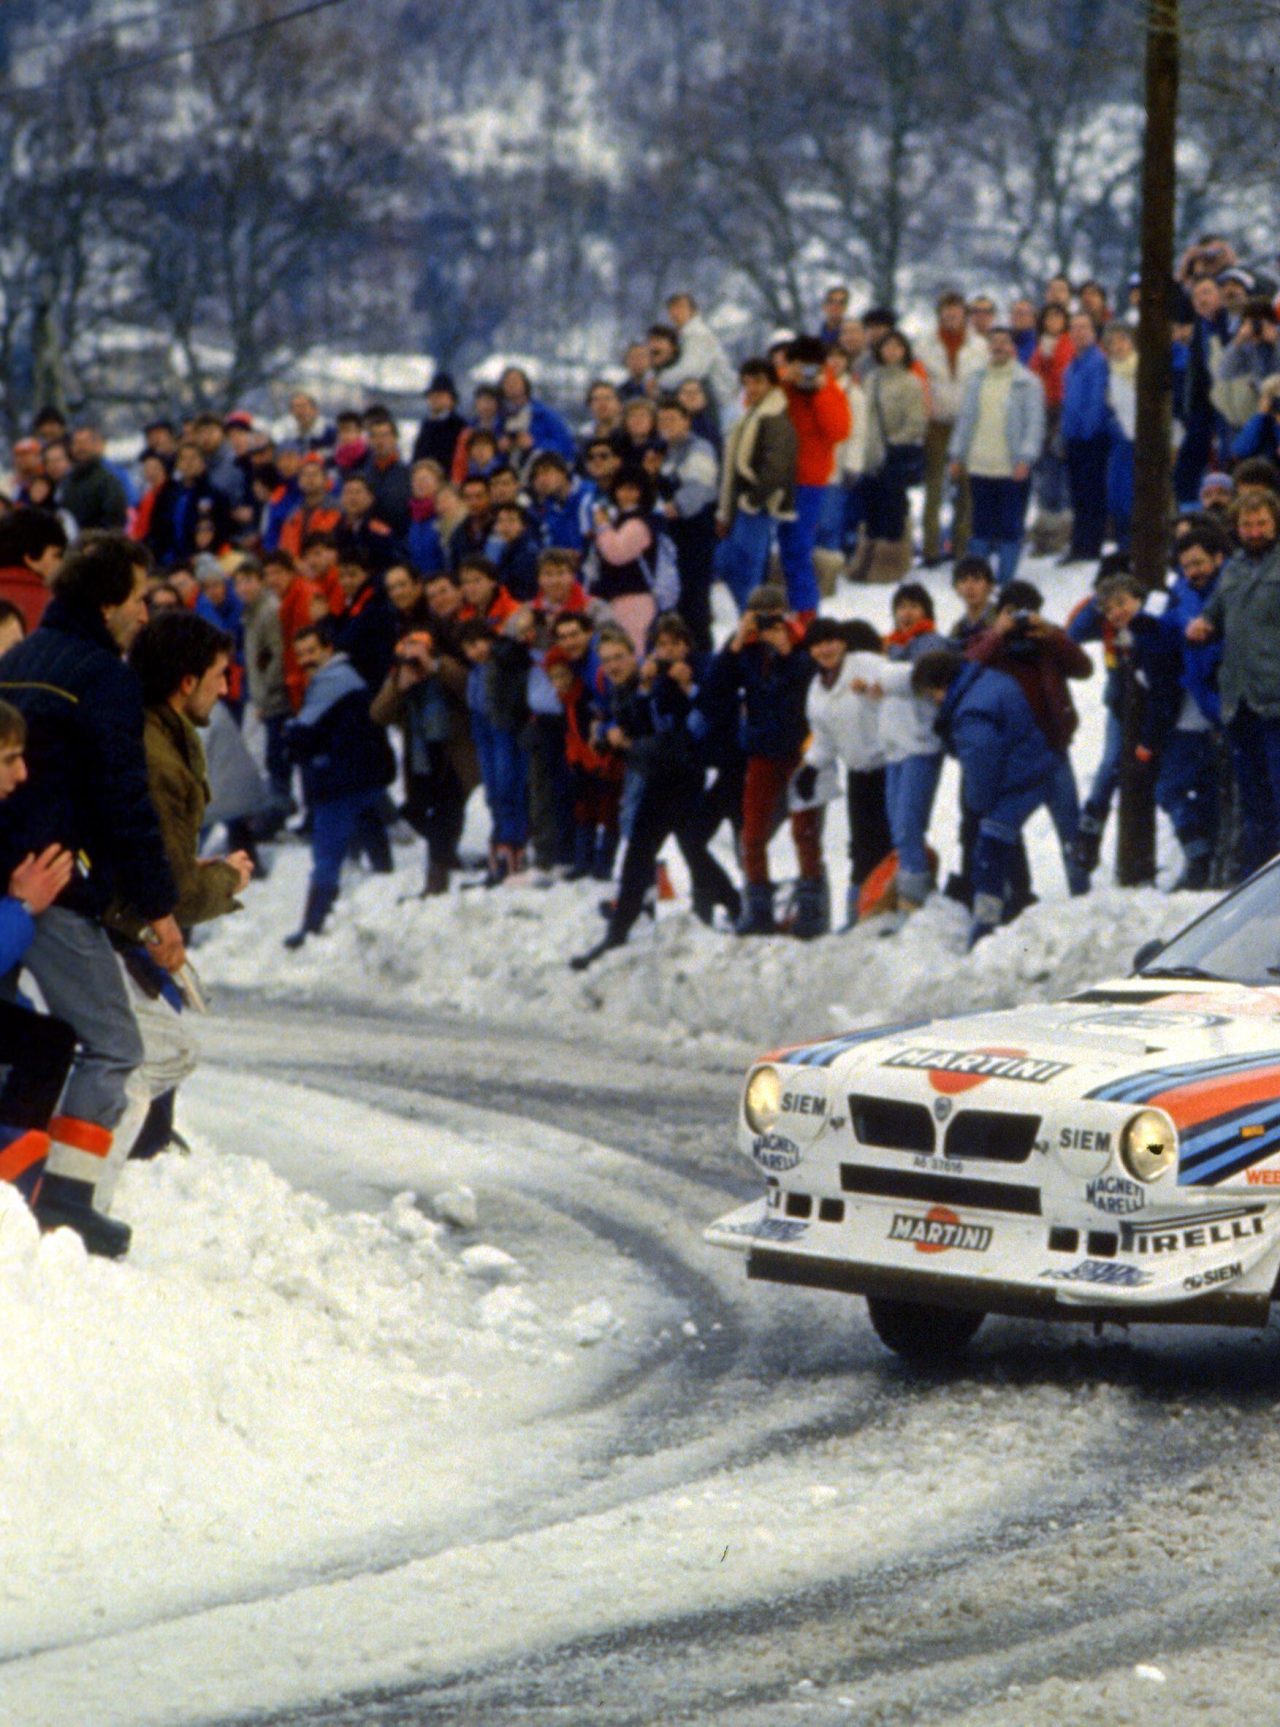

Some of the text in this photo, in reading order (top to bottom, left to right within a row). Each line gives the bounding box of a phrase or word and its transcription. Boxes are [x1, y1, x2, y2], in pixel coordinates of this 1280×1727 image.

[893, 1049, 1064, 1080] MARTINI
[781, 1092, 827, 1116] SIEM
[1060, 1128, 1111, 1152] SIEM
[893, 1217, 992, 1249] MARTINI
[1119, 1205, 1267, 1253] PIRELLI
[1205, 1262, 1243, 1286] SIEM
